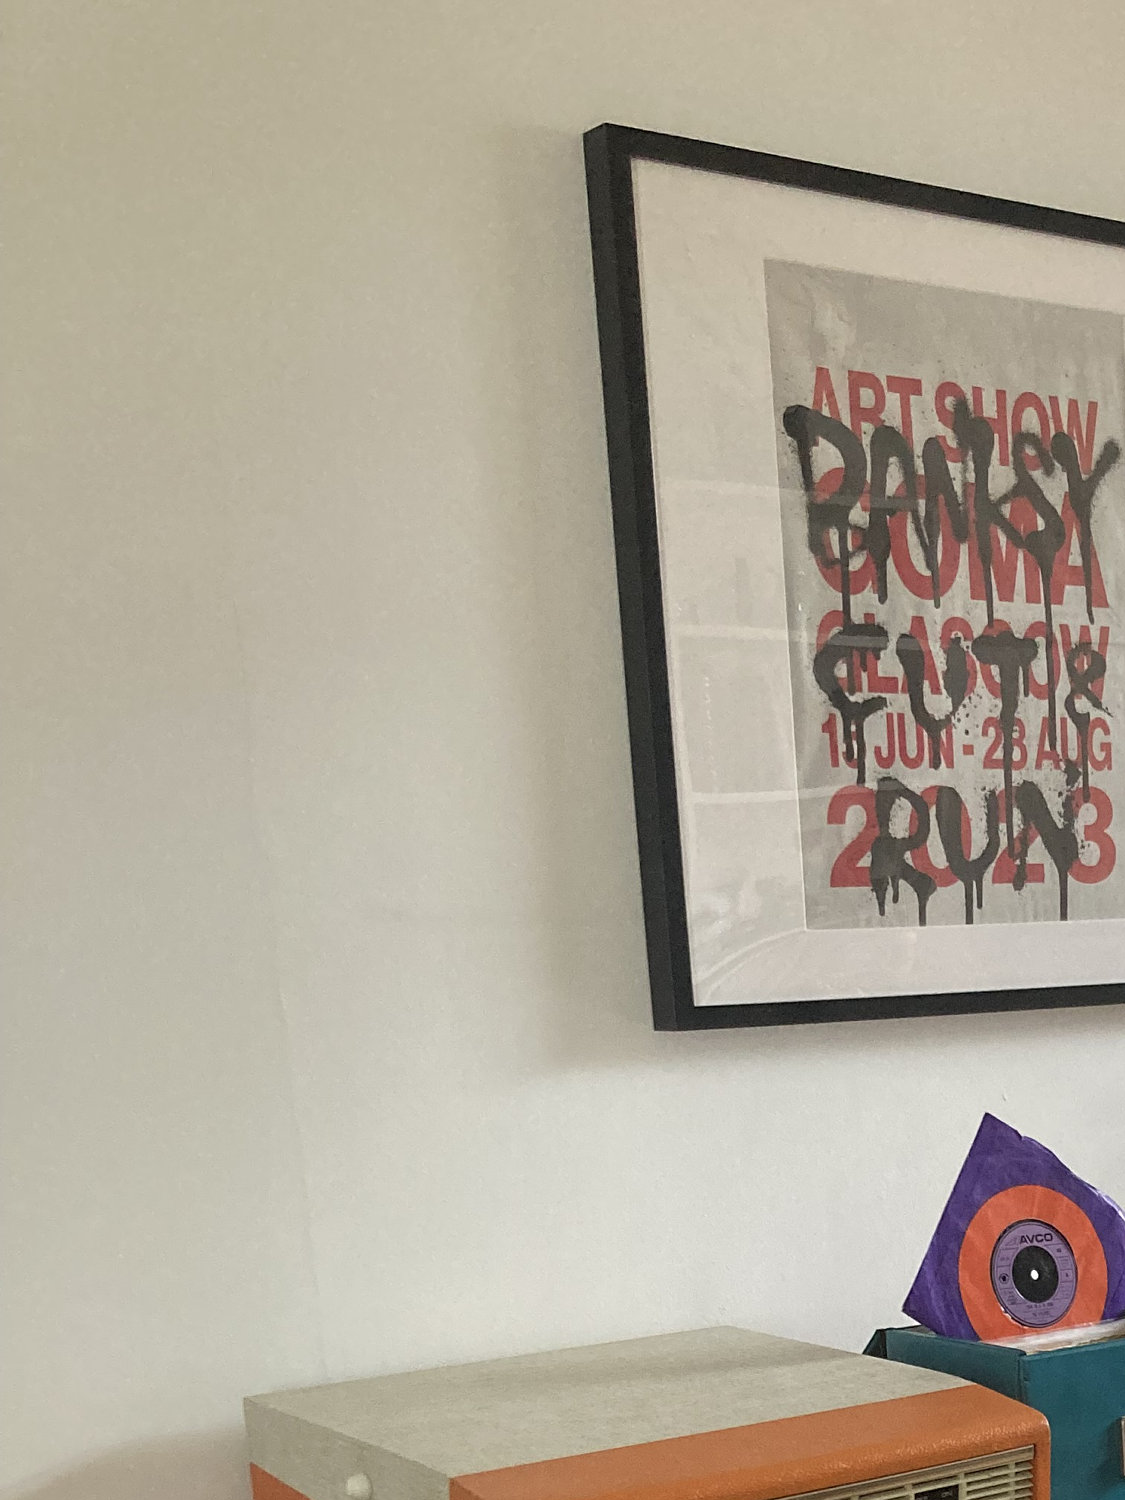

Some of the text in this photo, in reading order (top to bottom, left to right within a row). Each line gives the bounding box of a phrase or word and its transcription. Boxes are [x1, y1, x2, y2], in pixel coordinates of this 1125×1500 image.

[811, 365, 1099, 476] ART SHOW
[821, 712, 866, 770] 1
[873, 712, 955, 771] JUN
[1034, 716, 1114, 772] AUG
[870, 775, 1081, 905] RUN
[1019, 1232, 1054, 1245] AVCO
